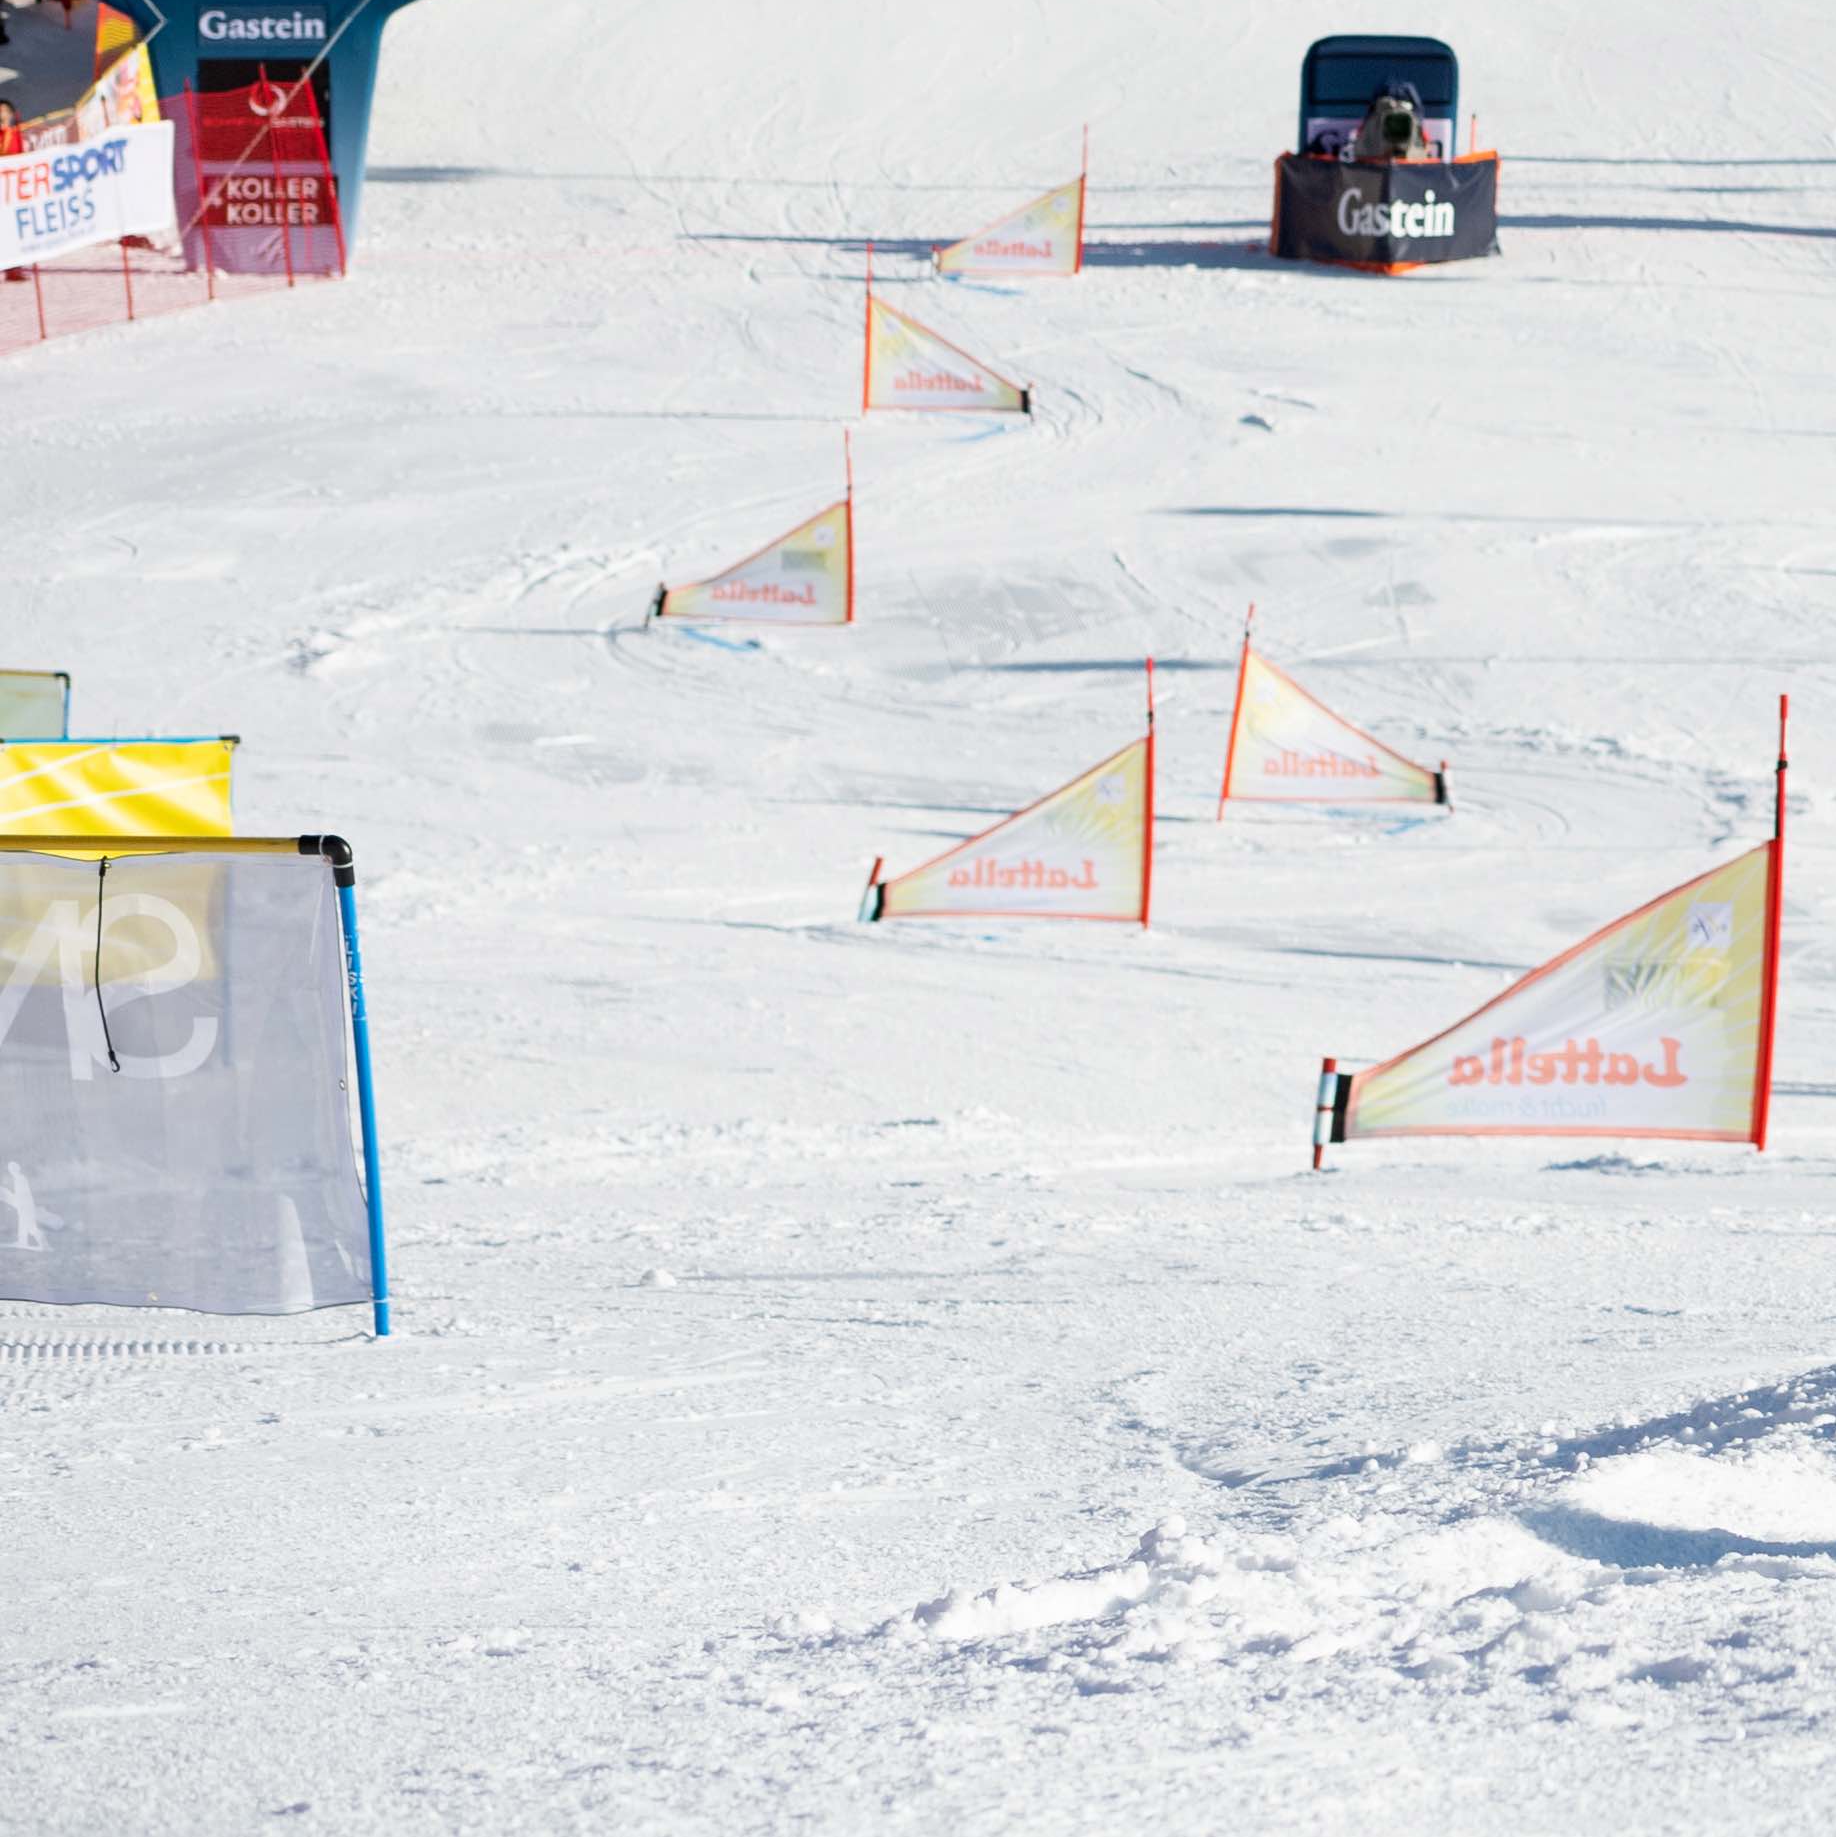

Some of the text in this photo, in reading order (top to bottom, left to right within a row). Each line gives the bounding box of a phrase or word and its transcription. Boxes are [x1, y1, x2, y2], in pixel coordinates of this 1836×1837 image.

[198, 10, 326, 40] Gastein
[0, 137, 129, 206] TERSPORT
[226, 176, 320, 201] KOLLER
[14, 186, 97, 241] FLEISS
[226, 203, 320, 225] KOLLER
[1336, 188, 1455, 238] Gastein
